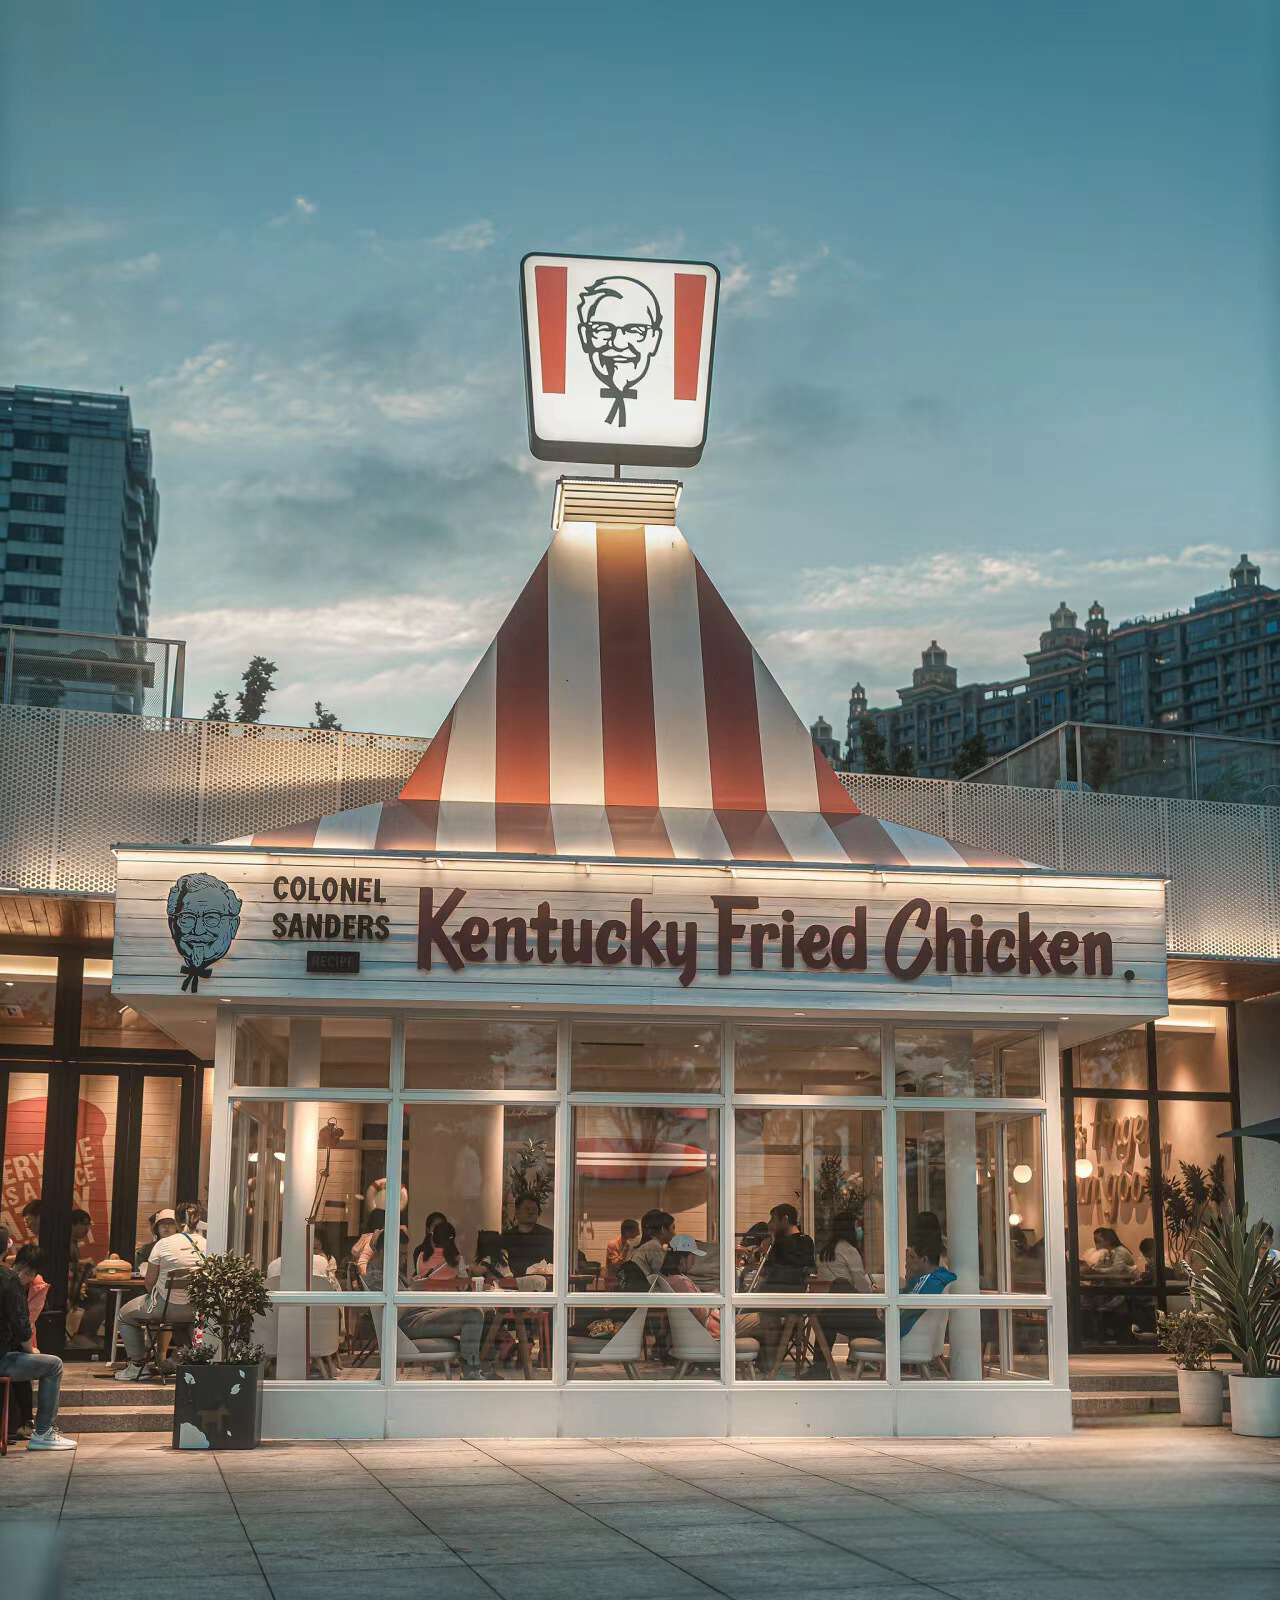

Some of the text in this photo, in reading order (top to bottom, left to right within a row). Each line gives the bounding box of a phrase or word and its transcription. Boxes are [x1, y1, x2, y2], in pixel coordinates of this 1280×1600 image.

[273, 876, 386, 903] COLONEL
[273, 912, 390, 940] SANDERS
[418, 886, 697, 987] Kentucky
[711, 895, 868, 976] Fried
[311, 955, 355, 969] RECIPE
